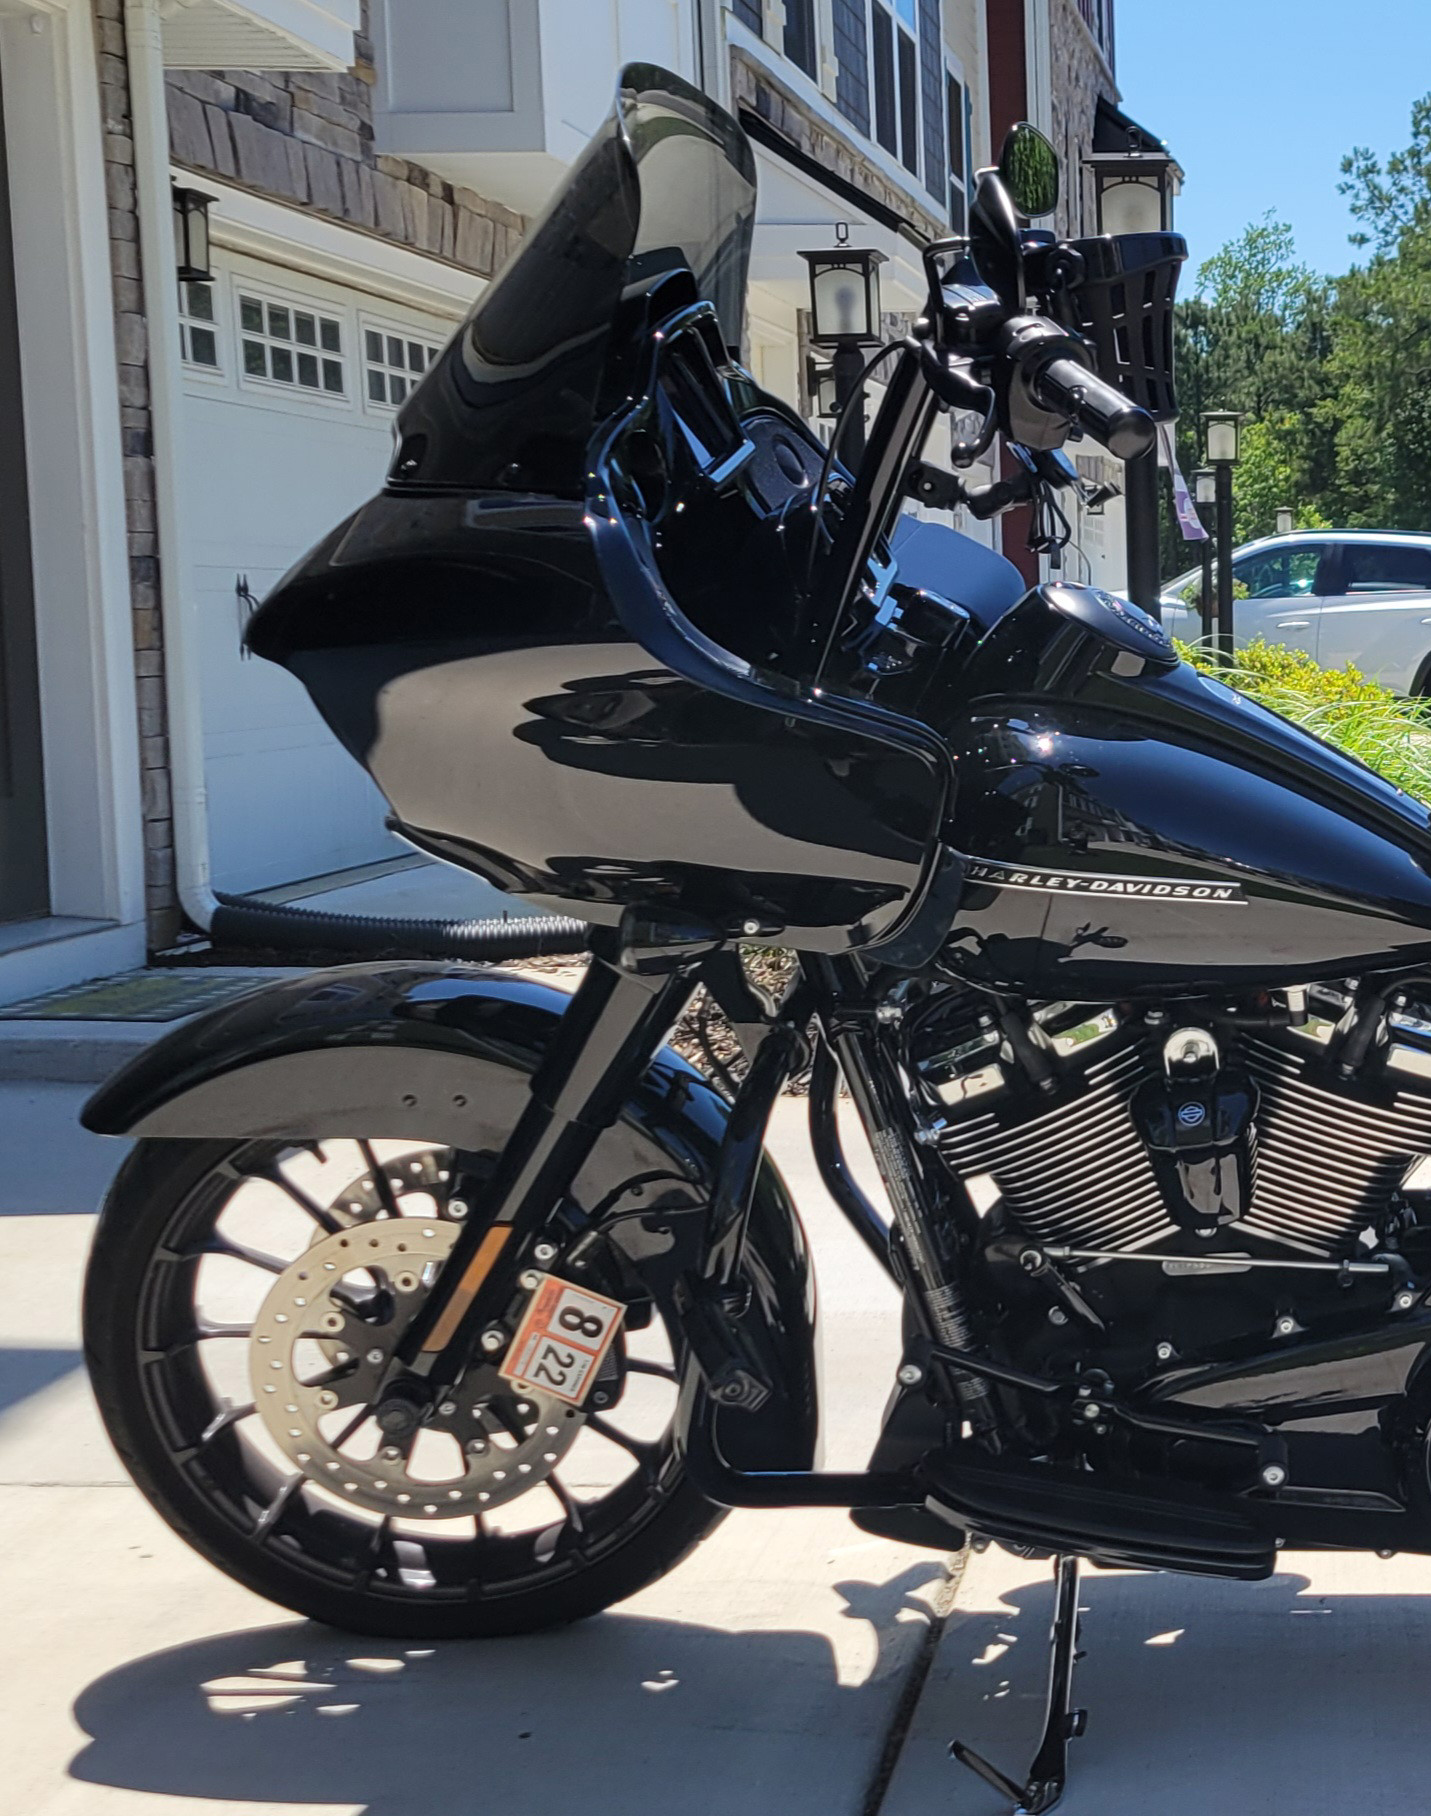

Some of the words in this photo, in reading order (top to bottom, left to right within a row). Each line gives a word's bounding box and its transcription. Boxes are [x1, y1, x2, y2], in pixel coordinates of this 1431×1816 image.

[969, 865, 1233, 899] HARLEY-DAVIDSON
[559, 1305, 603, 1338] 8
[534, 1345, 576, 1386] 22
